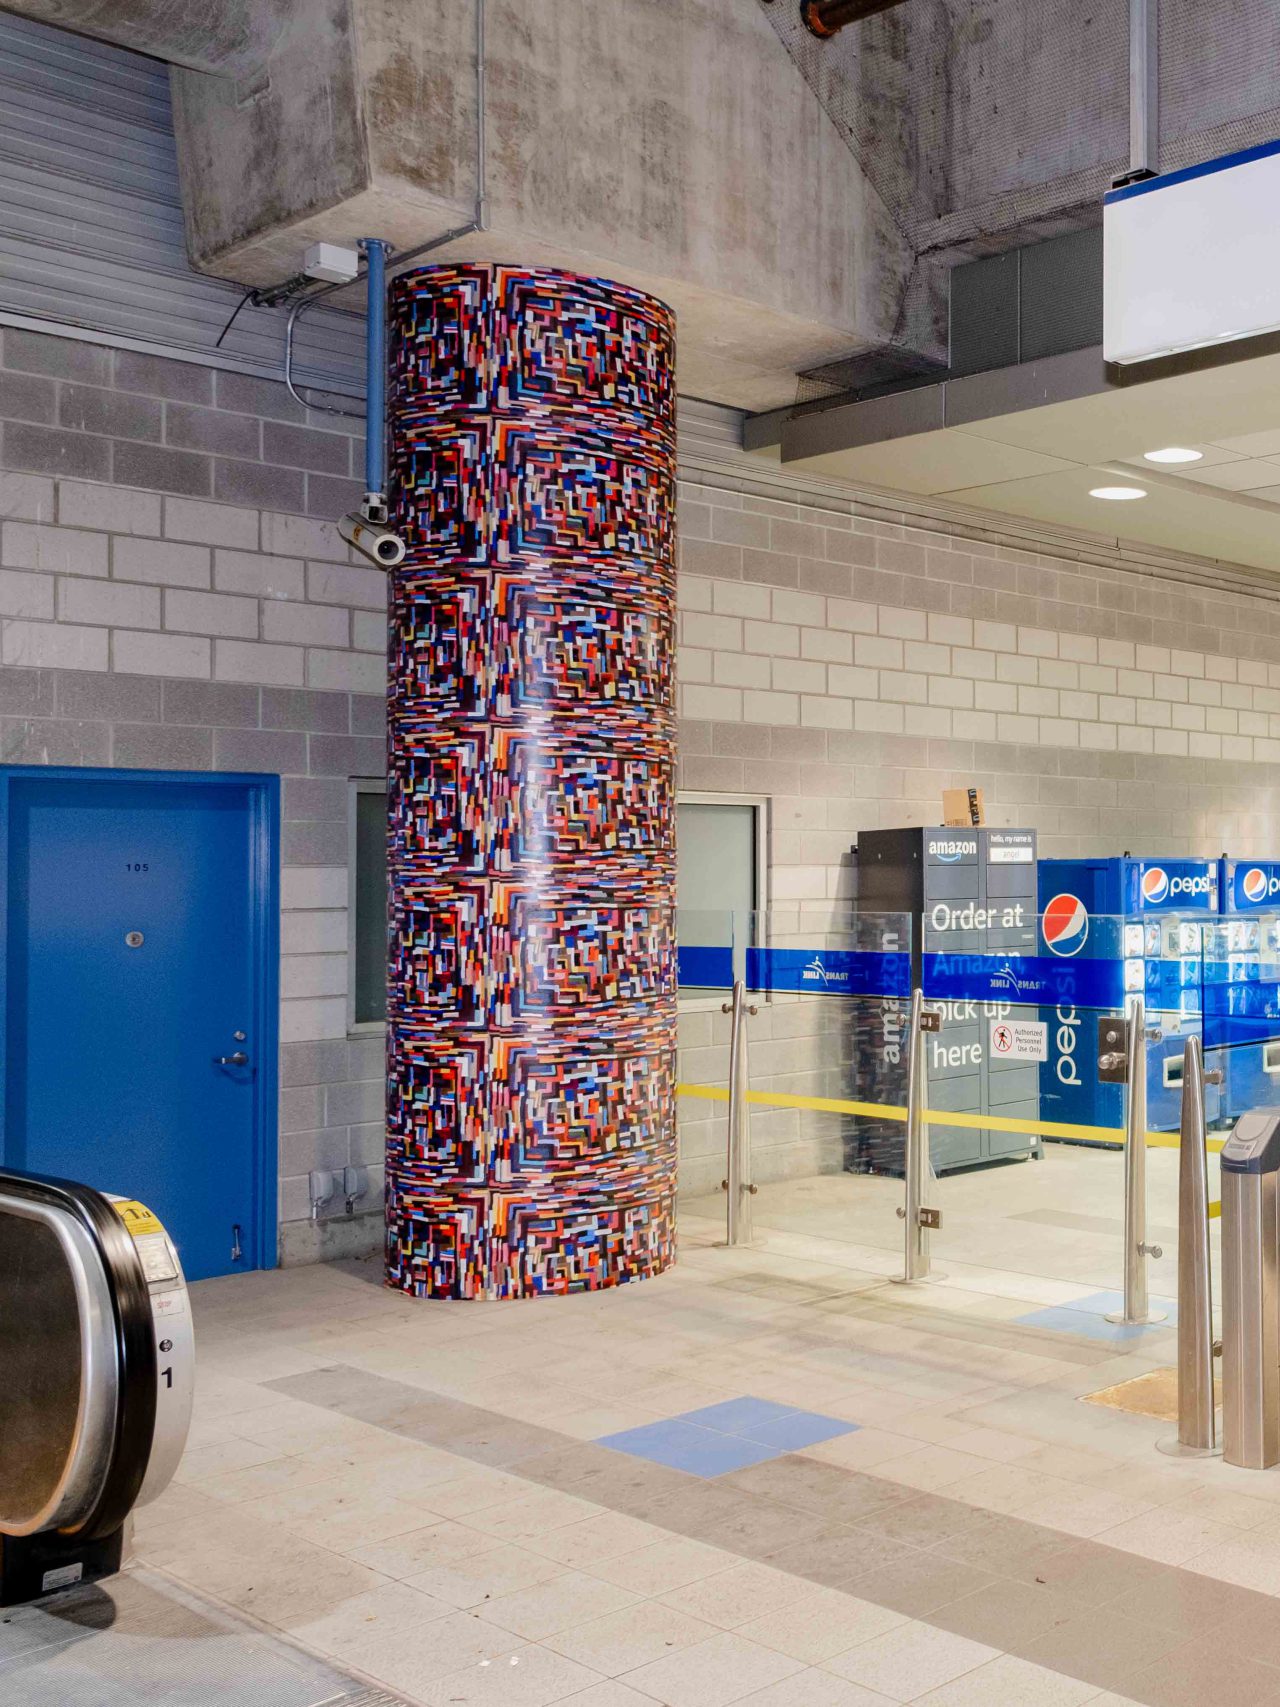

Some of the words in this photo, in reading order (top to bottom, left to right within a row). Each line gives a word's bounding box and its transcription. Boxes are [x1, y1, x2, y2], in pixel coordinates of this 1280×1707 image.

[929, 840, 977, 855] amazon
[125, 863, 149, 872] 105
[1170, 873, 1210, 897] pepsi
[931, 902, 997, 931] Order
[1001, 903, 1025, 928] at
[983, 995, 1011, 1021] up
[1015, 1028, 1043, 1037] Authorized
[1054, 966, 1082, 1086] pepsi
[1016, 1036, 1042, 1045] Personnel
[1017, 1044, 1028, 1053] Use
[1029, 1045, 1042, 1055] Only
[933, 1040, 983, 1069] here
[161, 1366, 173, 1389] 1
